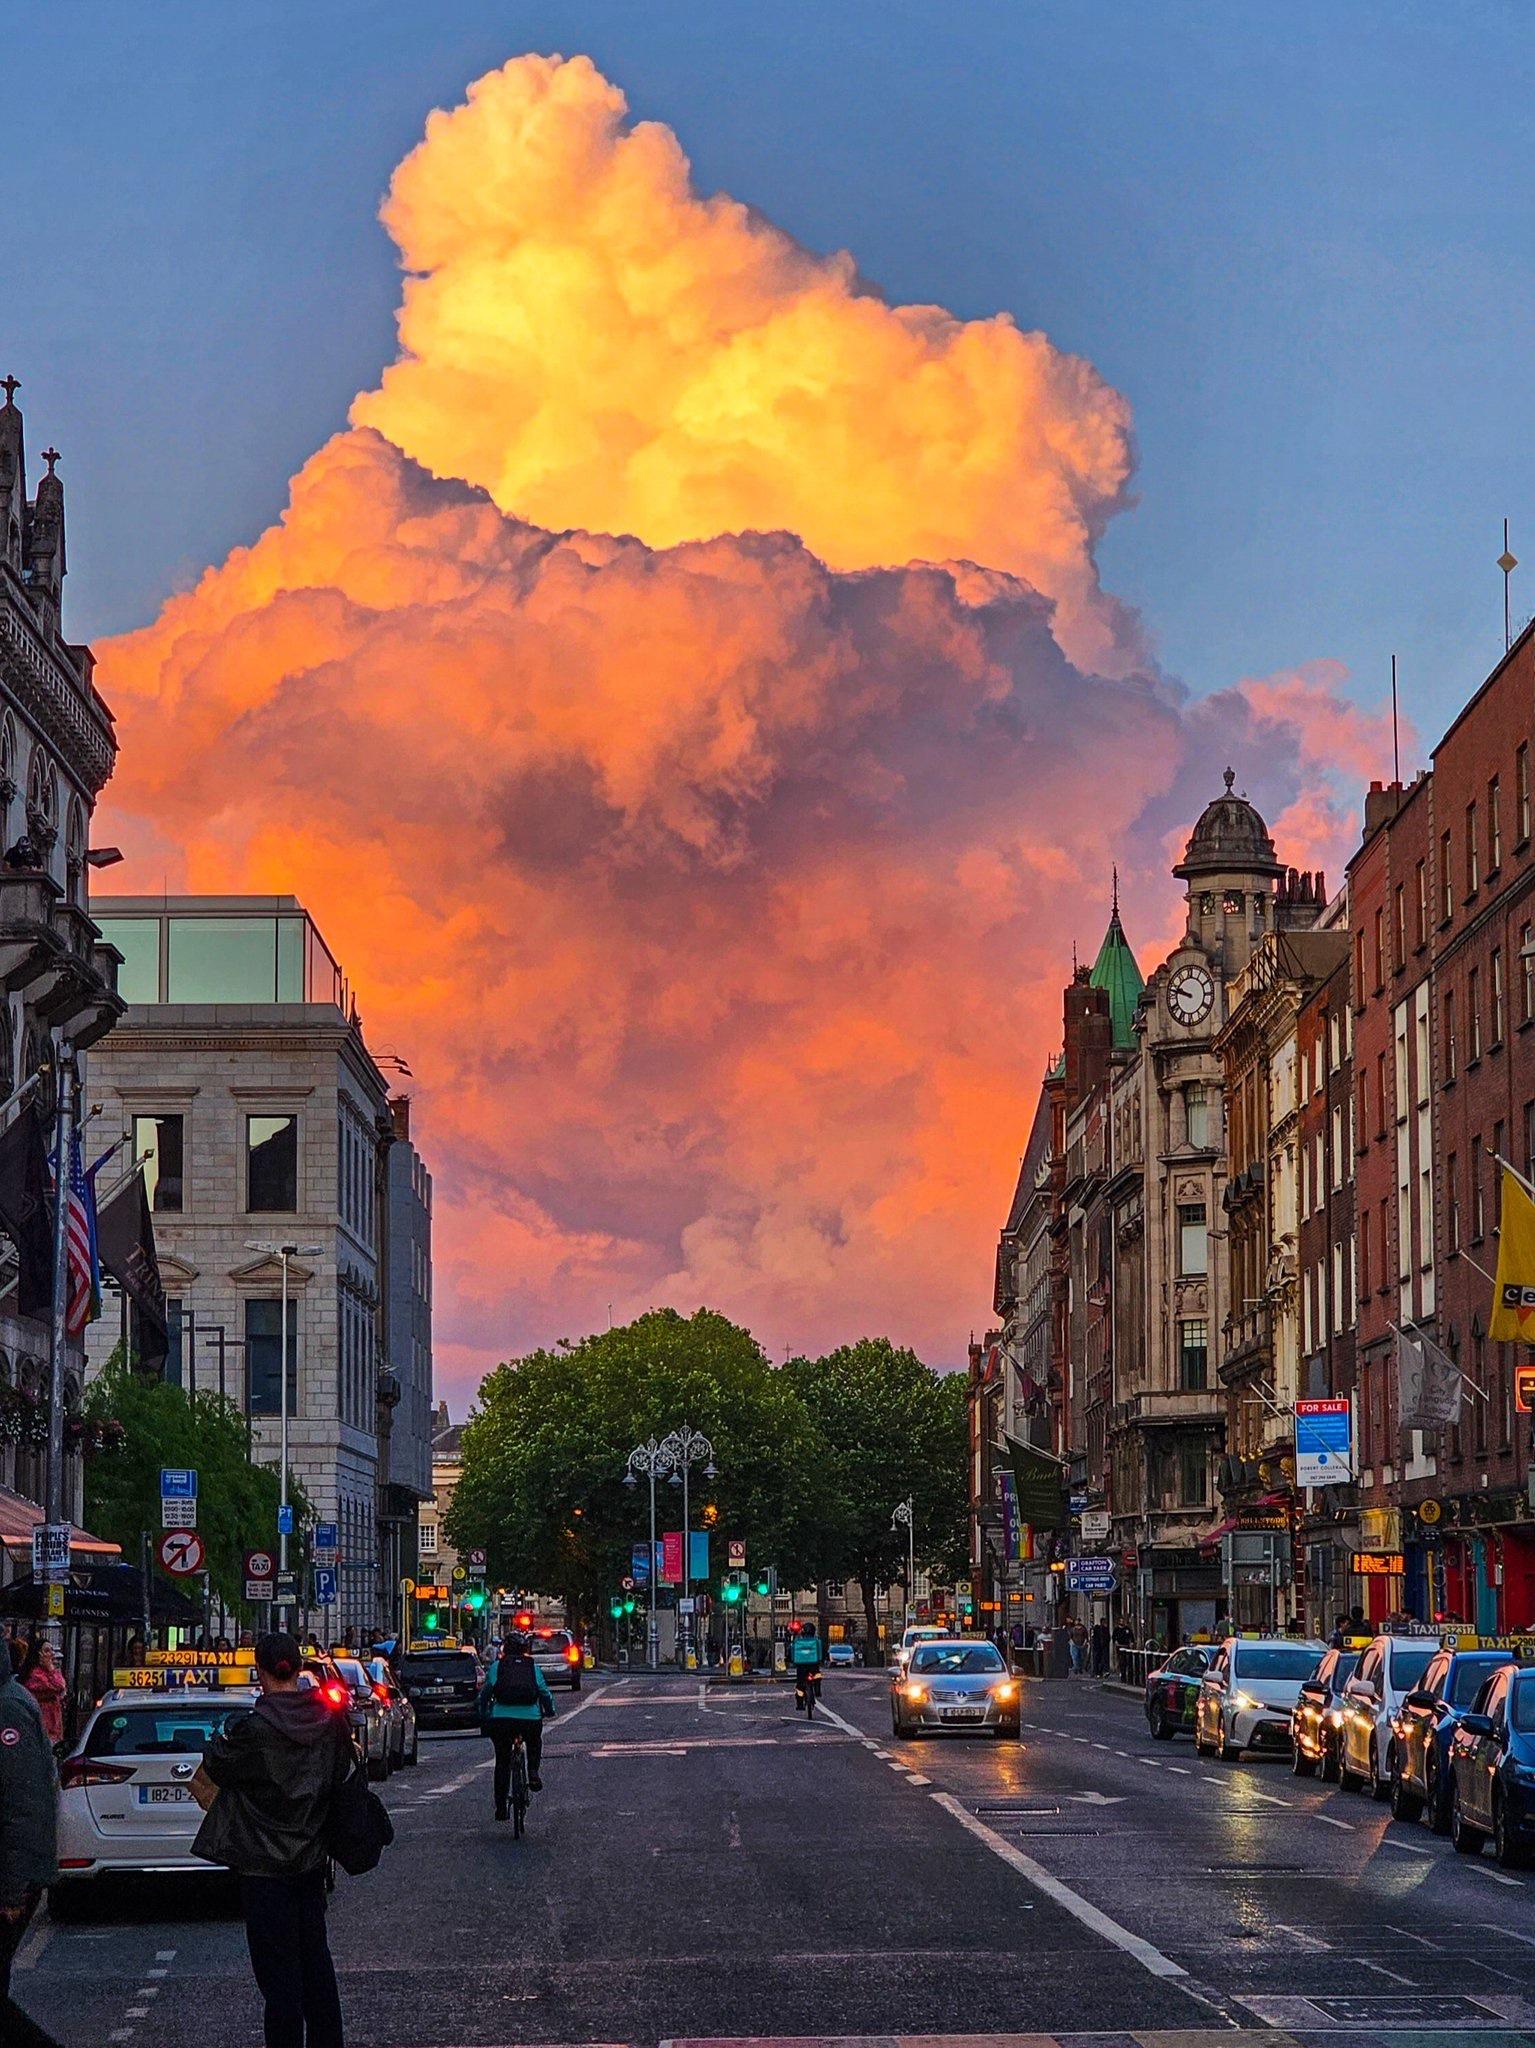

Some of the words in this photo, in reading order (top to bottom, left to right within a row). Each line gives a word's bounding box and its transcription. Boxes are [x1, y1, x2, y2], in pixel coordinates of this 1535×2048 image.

[1301, 1404, 1319, 1412] FOR
[1322, 1403, 1342, 1412] SALE
[251, 1563, 269, 1571] TAXI
[1070, 1562, 1077, 1571] P
[320, 1573, 330, 1590] P
[1070, 1578, 1078, 1588] P
[70, 1607, 110, 1617] GUINNESS
[1413, 1624, 1439, 1634] TAXI
[1448, 1635, 1457, 1646] D
[1480, 1637, 1510, 1648] TAXI
[199, 1652, 233, 1665] TAXI
[129, 1671, 165, 1686] 36251
[172, 1670, 213, 1685] TAXI
